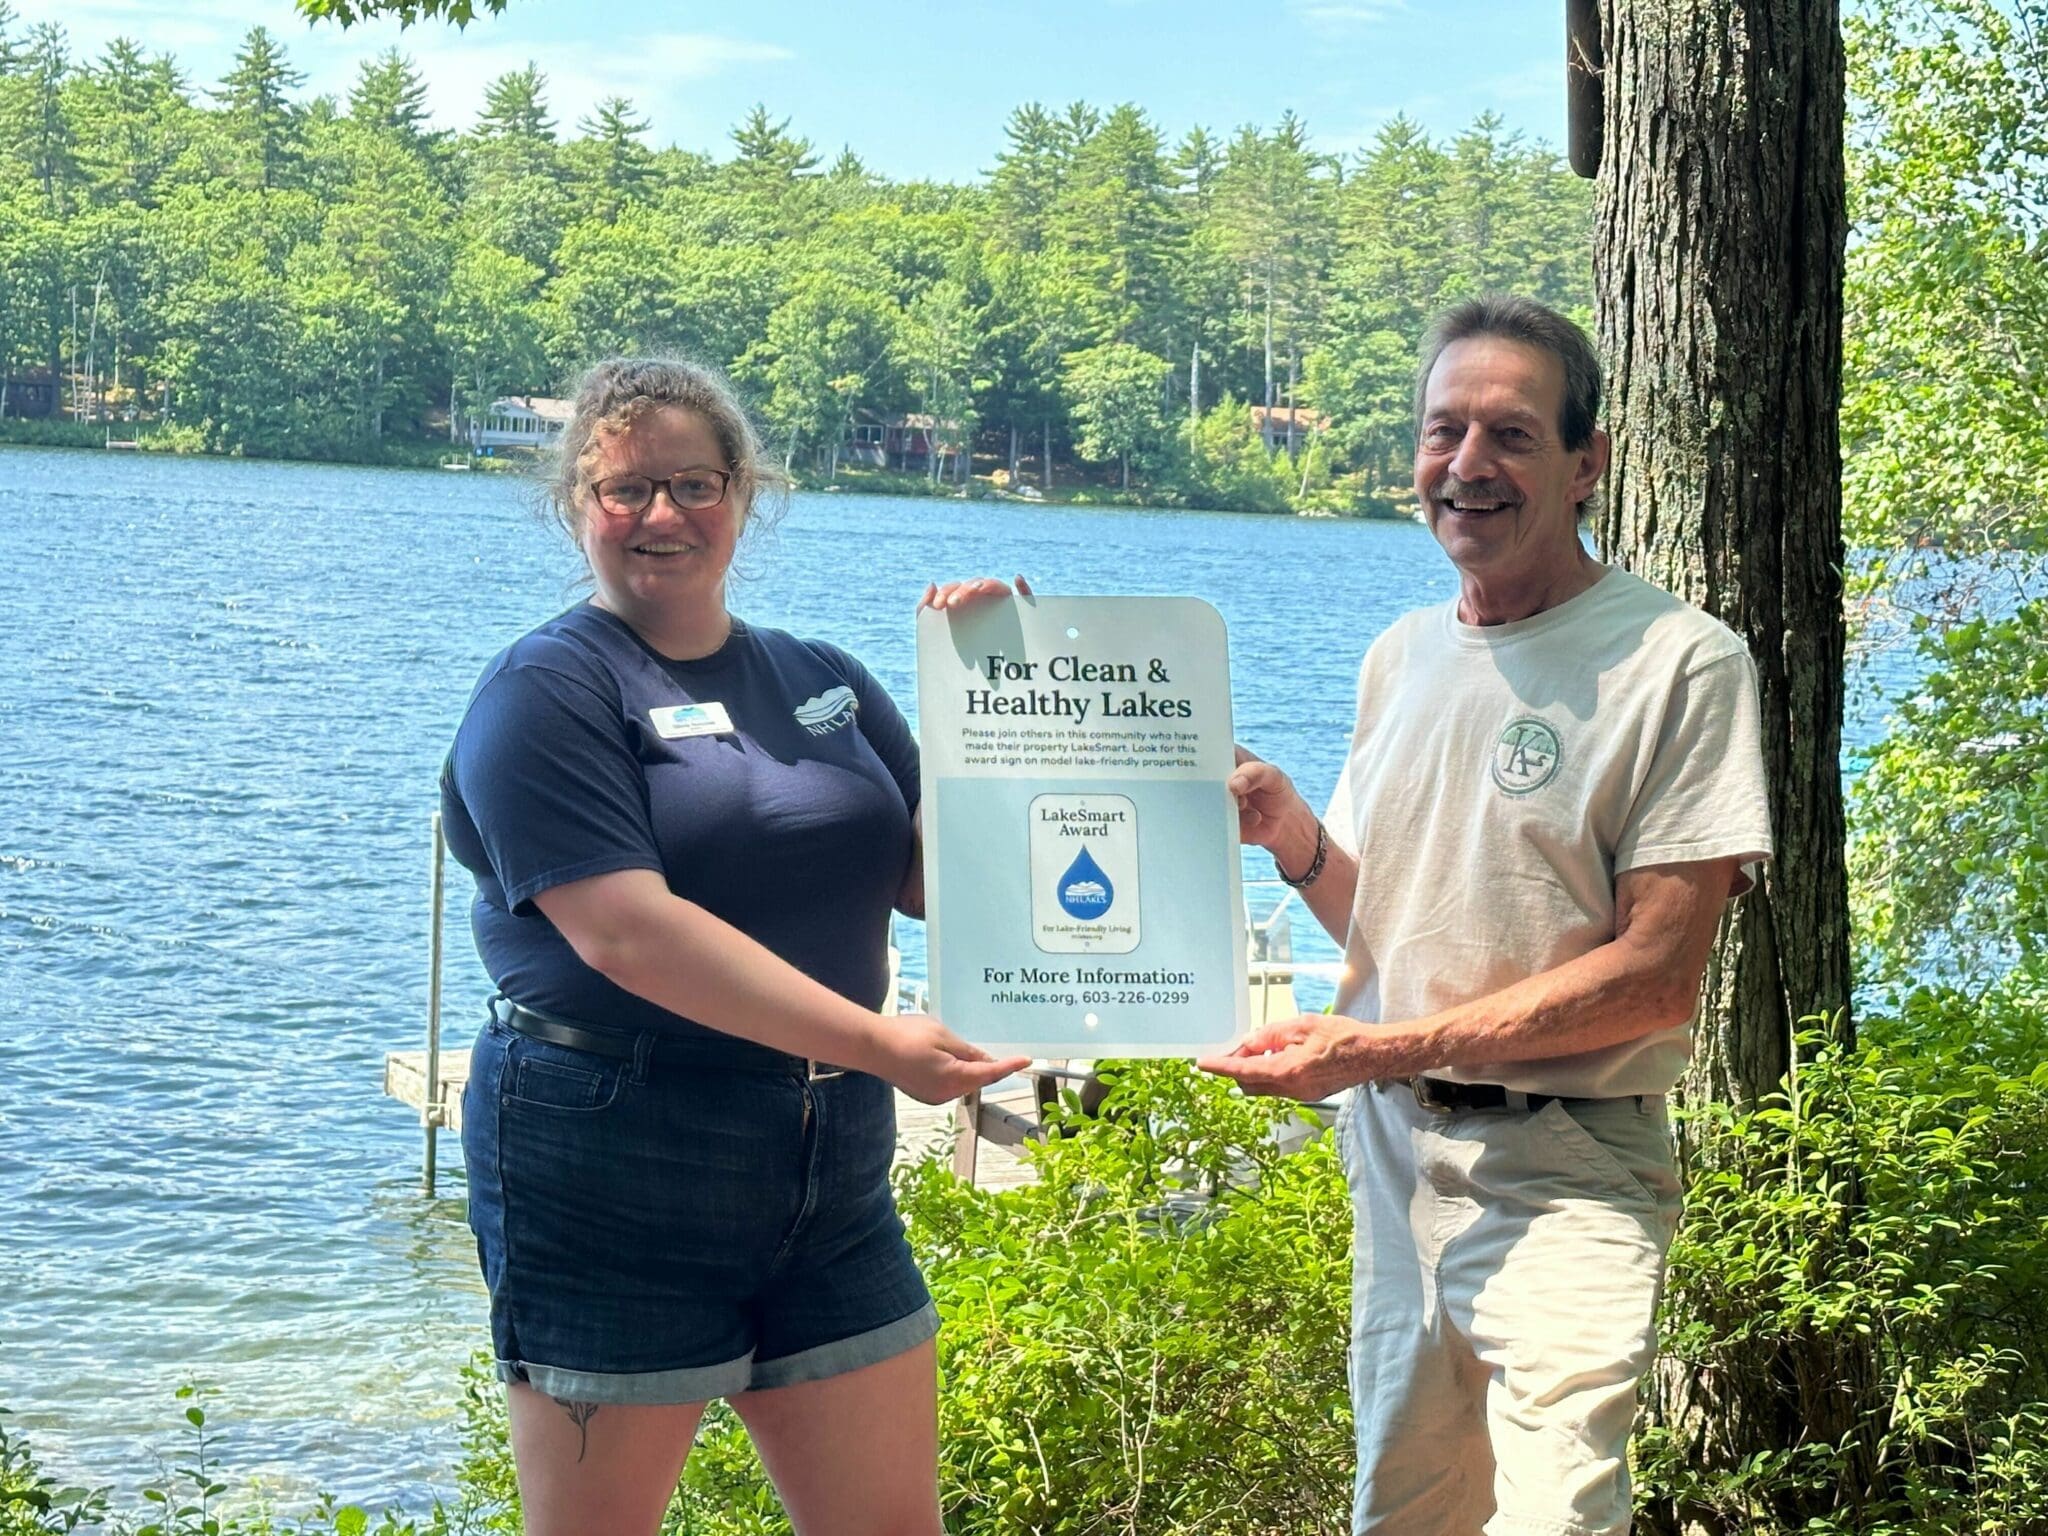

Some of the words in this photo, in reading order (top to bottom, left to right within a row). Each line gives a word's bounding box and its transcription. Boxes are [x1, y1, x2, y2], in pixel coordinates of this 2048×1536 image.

[986, 655, 1038, 681] For
[1048, 655, 1137, 683] Clean
[1147, 657, 1171, 683] &
[965, 689, 1090, 725] Healthy
[1101, 692, 1193, 718] Lakes
[962, 727, 996, 738] Please
[998, 728, 1017, 740] join
[1019, 728, 1052, 739] others
[1055, 729, 1065, 739] in
[1067, 729, 1087, 740] this
[1089, 730, 1147, 742] community
[1149, 731, 1172, 741] who
[1174, 731, 1199, 741] have
[965, 742, 995, 751] made
[997, 742, 1021, 751] their
[1023, 743, 1068, 754] property
[1071, 742, 1130, 753] LakeSmart.
[1132, 743, 1158, 753] Look
[1160, 744, 1175, 754] for
[1177, 744, 1197, 754] this
[964, 755, 998, 765] award
[1000, 755, 1022, 766] sign
[1024, 757, 1038, 766] on
[1040, 756, 1072, 766] model
[1074, 756, 1140, 768] lake-friendly
[1142, 757, 1198, 768] properties.
[1041, 808, 1126, 823] LakeSmart
[1058, 823, 1109, 837] Award
[1042, 924, 1054, 933] For
[1108, 925, 1132, 935] Living
[983, 967, 1014, 984] For
[1020, 967, 1071, 985] More
[1076, 967, 1195, 986] Information:
[991, 990, 1078, 1006] nhlakes.org,
[1082, 990, 1190, 1005] 603-226-0299
